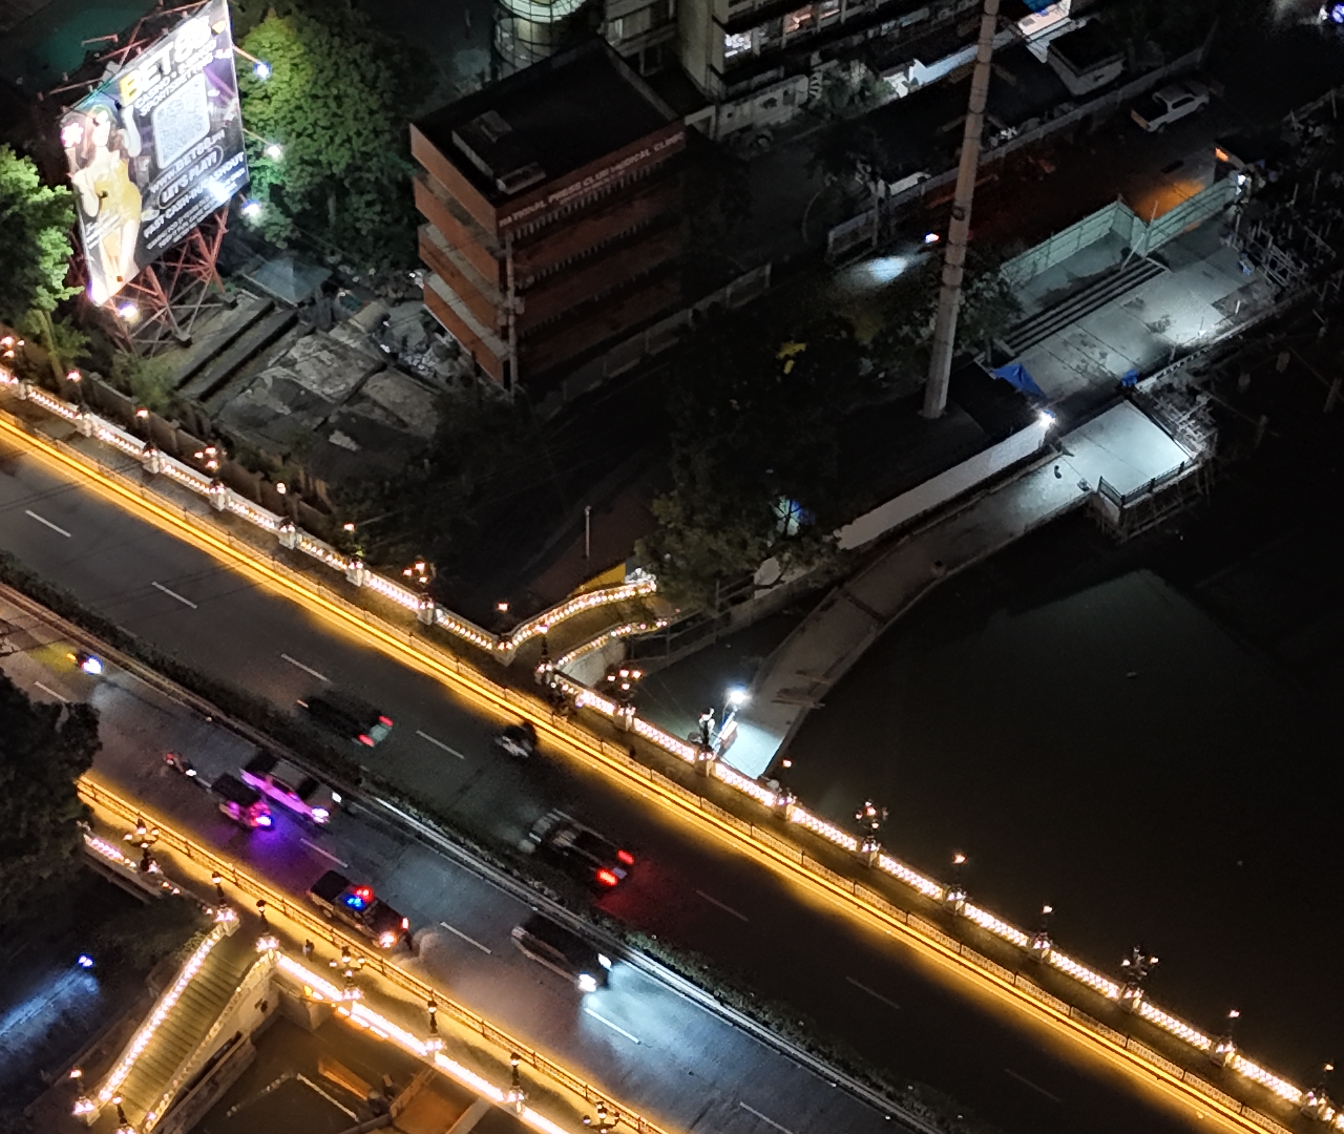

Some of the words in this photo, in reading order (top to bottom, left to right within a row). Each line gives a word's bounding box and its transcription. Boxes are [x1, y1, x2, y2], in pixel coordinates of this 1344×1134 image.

[134, 76, 170, 109] CASINO
[499, 200, 548, 227] NATIONAL
[548, 181, 581, 203] PRESS
[583, 167, 610, 186] CLUB
[611, 148, 651, 172] MEDICAL
[653, 131, 685, 152] CLINIC
[144, 214, 164, 238] FAST
